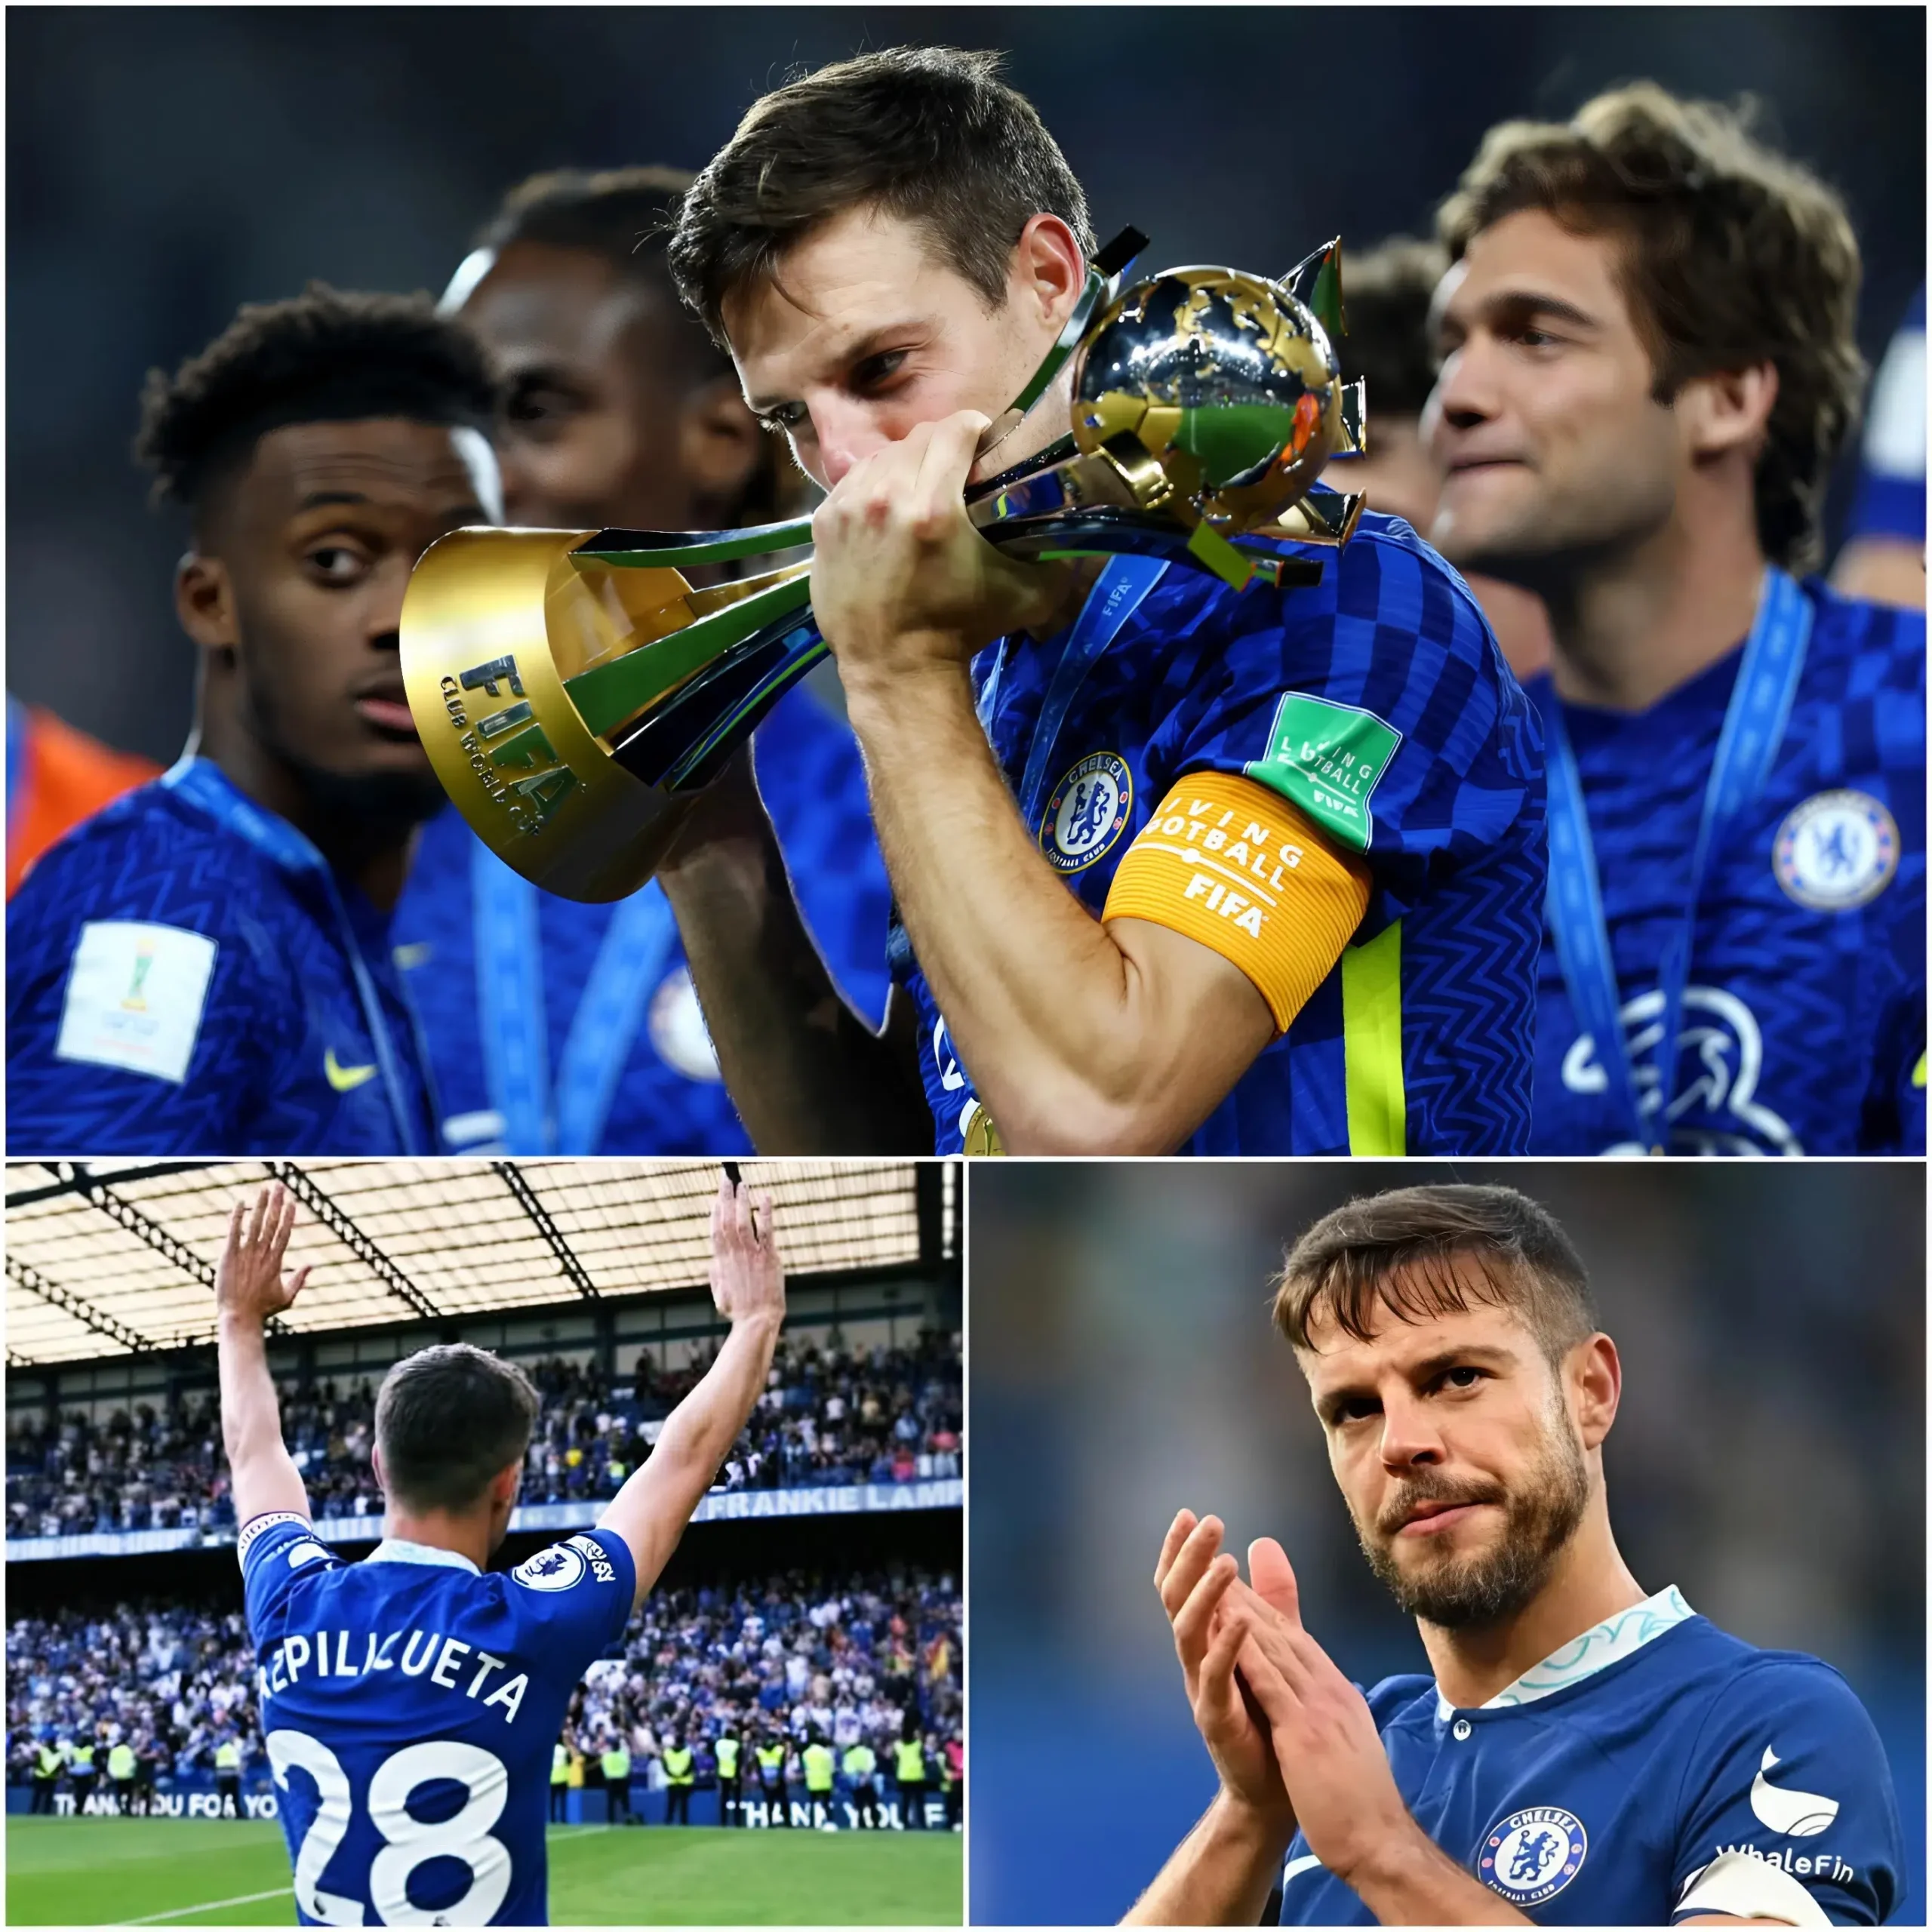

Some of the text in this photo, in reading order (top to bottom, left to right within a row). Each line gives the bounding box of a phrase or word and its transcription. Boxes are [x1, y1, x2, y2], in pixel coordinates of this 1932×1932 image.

[459, 654, 580, 824] FIFA
[1069, 755, 1124, 783] CHELSEA
[1145, 816, 1284, 892] OOTBALL
[1164, 797, 1303, 869] IVING
[1183, 873, 1264, 939] FIFA
[706, 1487, 860, 1520] FRANKIE
[244, 1794, 278, 1818] YO
[266, 1728, 512, 1927] 28
[1510, 1810, 1577, 1835] CHELSEA
